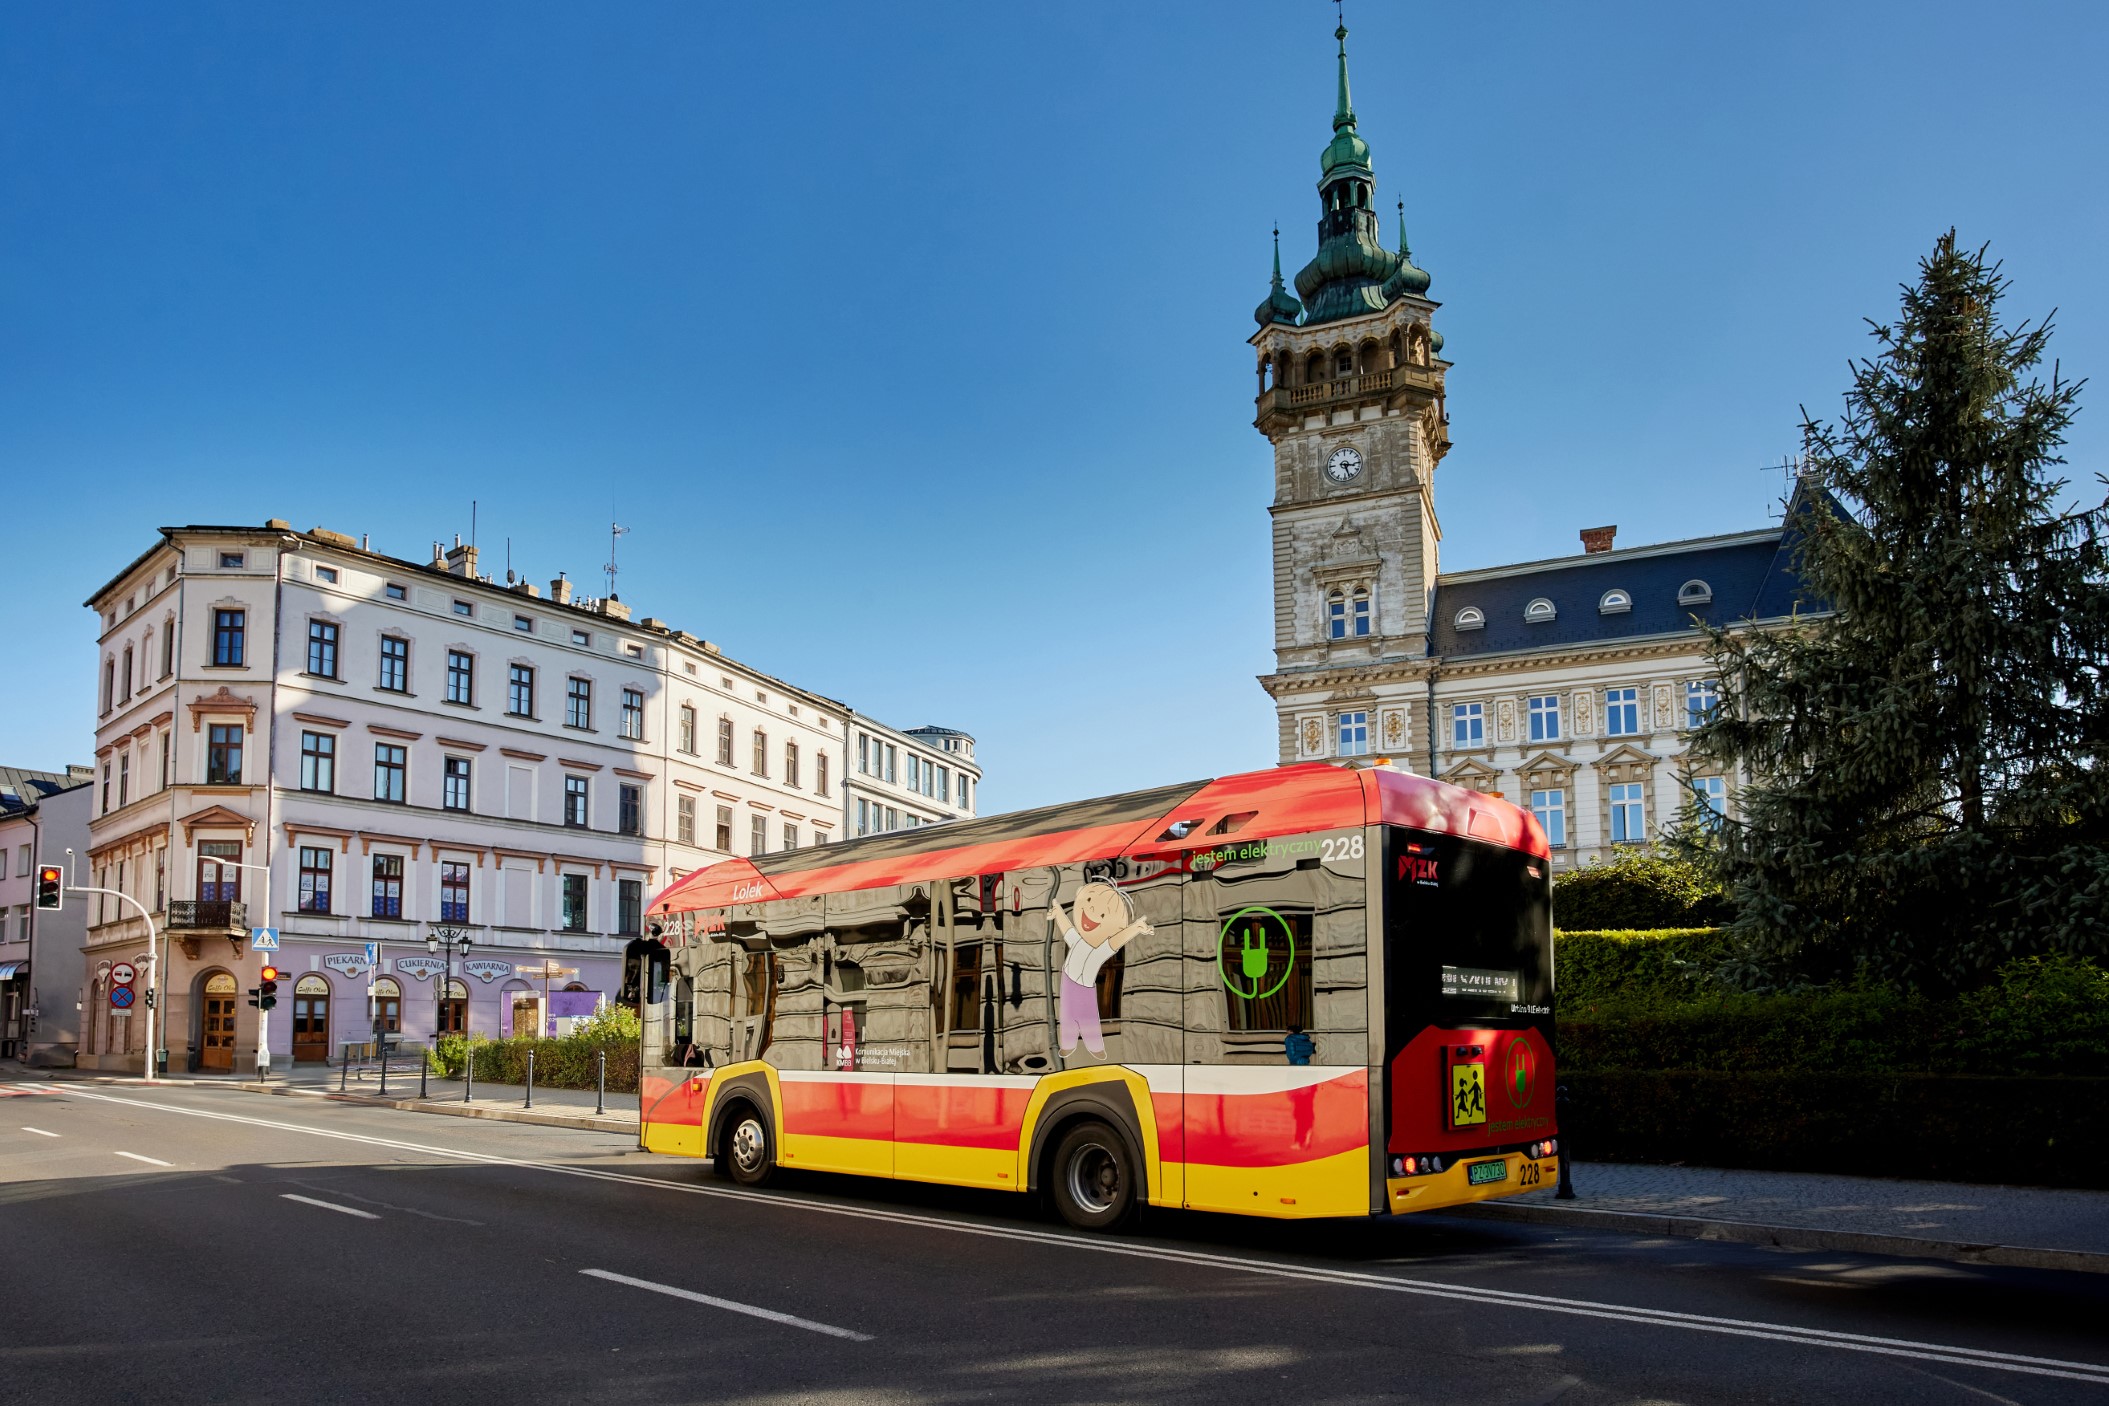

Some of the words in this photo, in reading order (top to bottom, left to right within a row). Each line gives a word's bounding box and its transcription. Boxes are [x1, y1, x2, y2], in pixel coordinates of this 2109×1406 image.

[1192, 850, 1237, 869] jestem
[1240, 838, 1322, 860] elektryczny
[1320, 834, 1365, 863] 228
[1398, 855, 1438, 882] MZK
[733, 881, 763, 900] Lolek
[663, 920, 680, 936] 228
[327, 955, 367, 965] PIEKARN
[399, 959, 446, 971] CUKIERNIA
[466, 963, 509, 973] KAWIARNIA
[855, 1048, 888, 1057] Komunikacja
[888, 1047, 911, 1058] Miejska
[1487, 1118, 1513, 1137] jestem
[1515, 1115, 1549, 1132] elektryczny
[1520, 1162, 1540, 1186] 228
